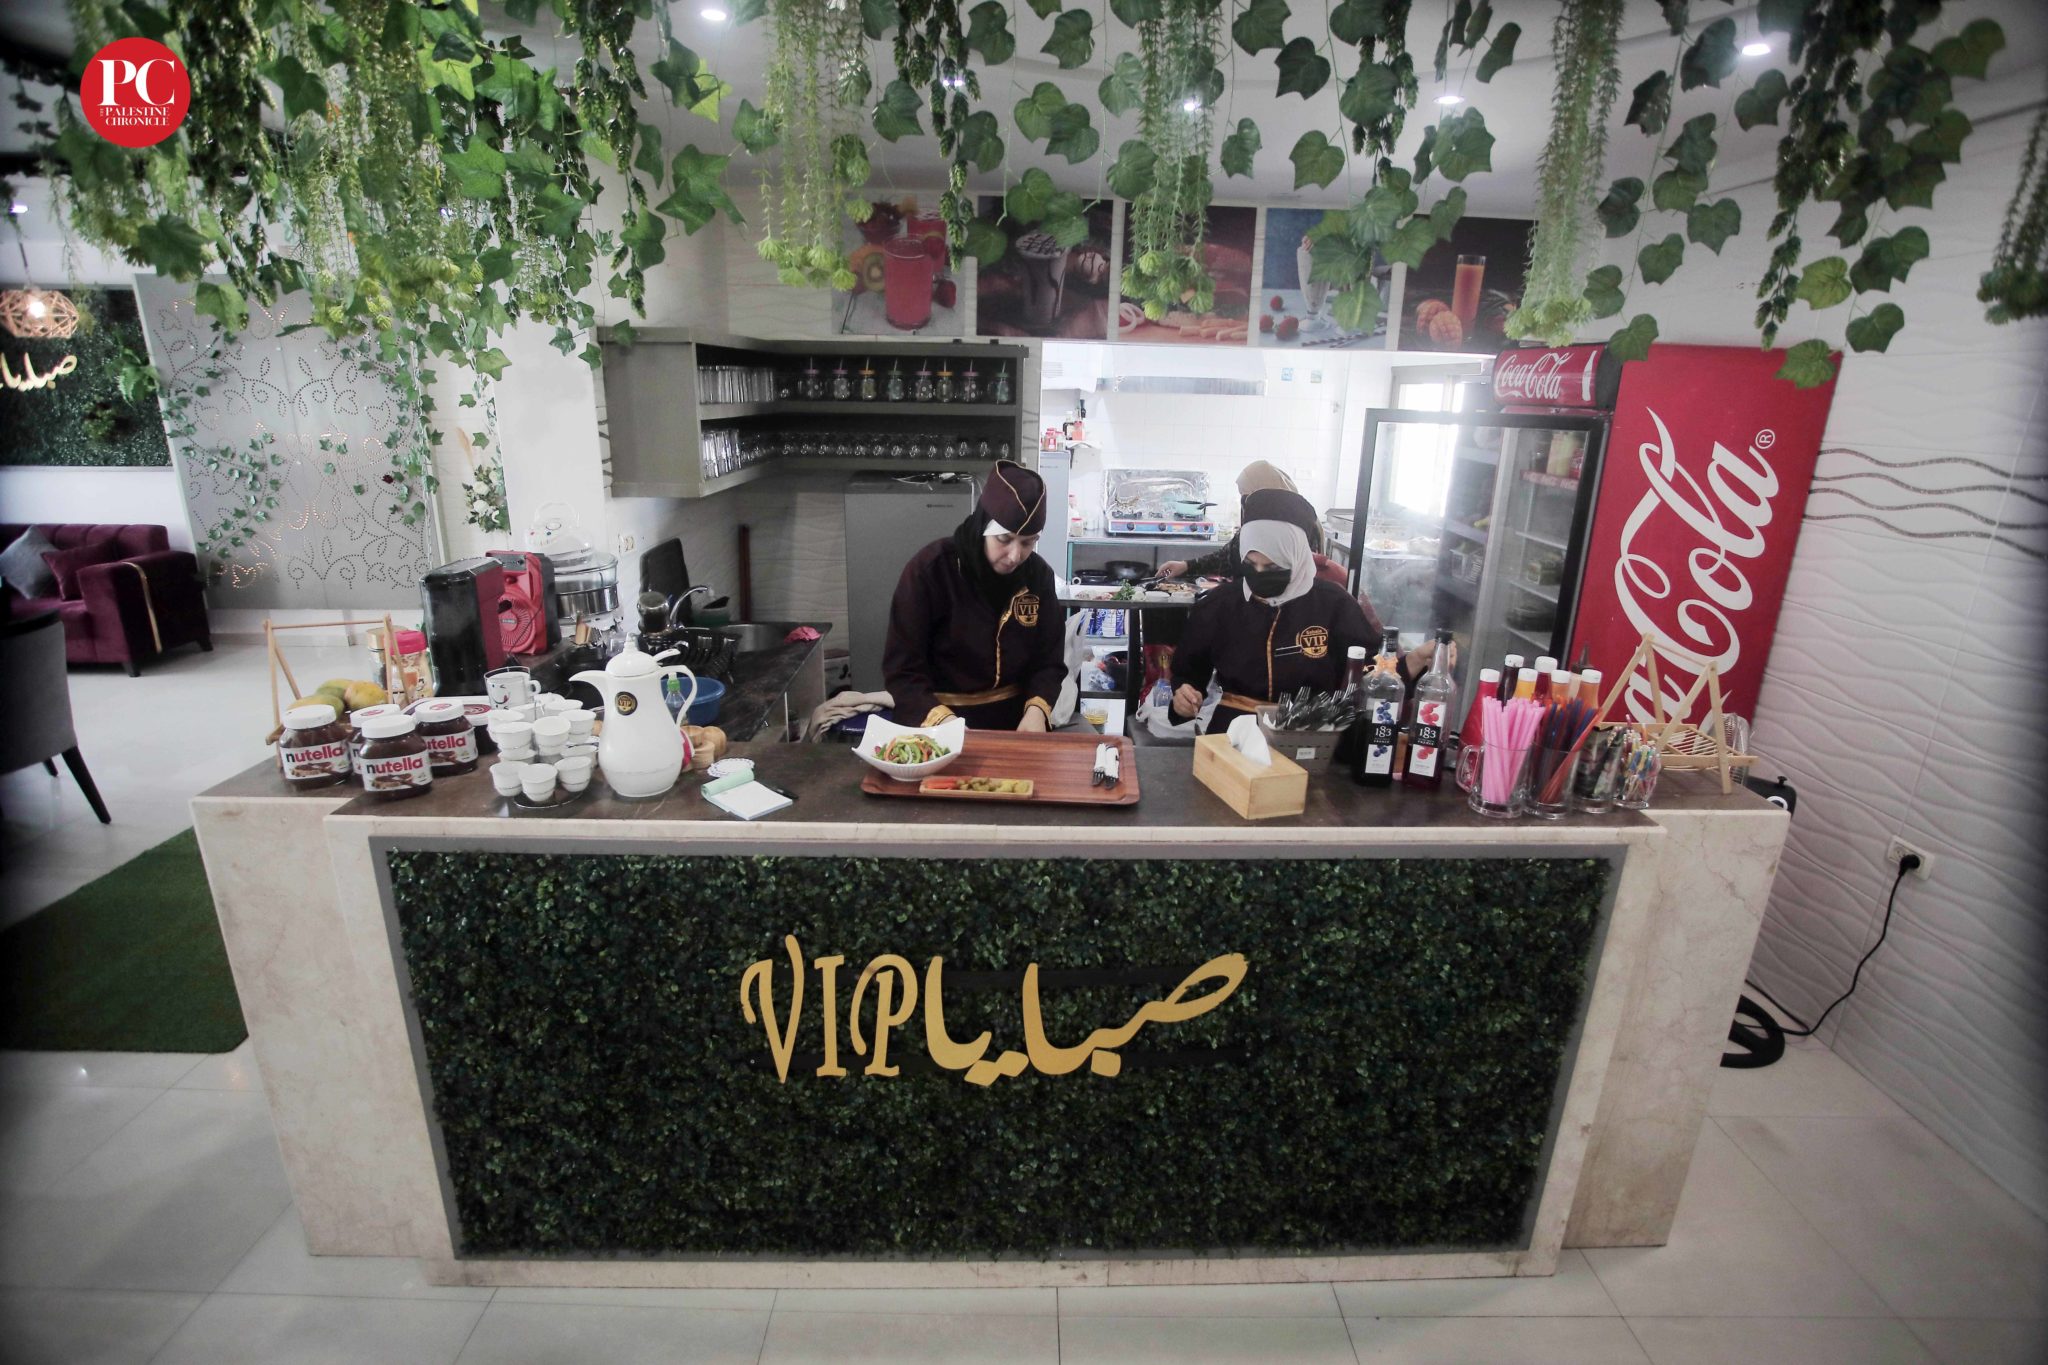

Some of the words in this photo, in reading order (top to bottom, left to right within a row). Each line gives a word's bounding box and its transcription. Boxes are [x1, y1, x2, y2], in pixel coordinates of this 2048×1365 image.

[1303, 635, 1327, 647] VIP
[286, 745, 344, 763] nutella
[366, 757, 424, 774] nutella
[740, 934, 918, 1083] VIP
[925, 953, 1249, 1087] صبايا
